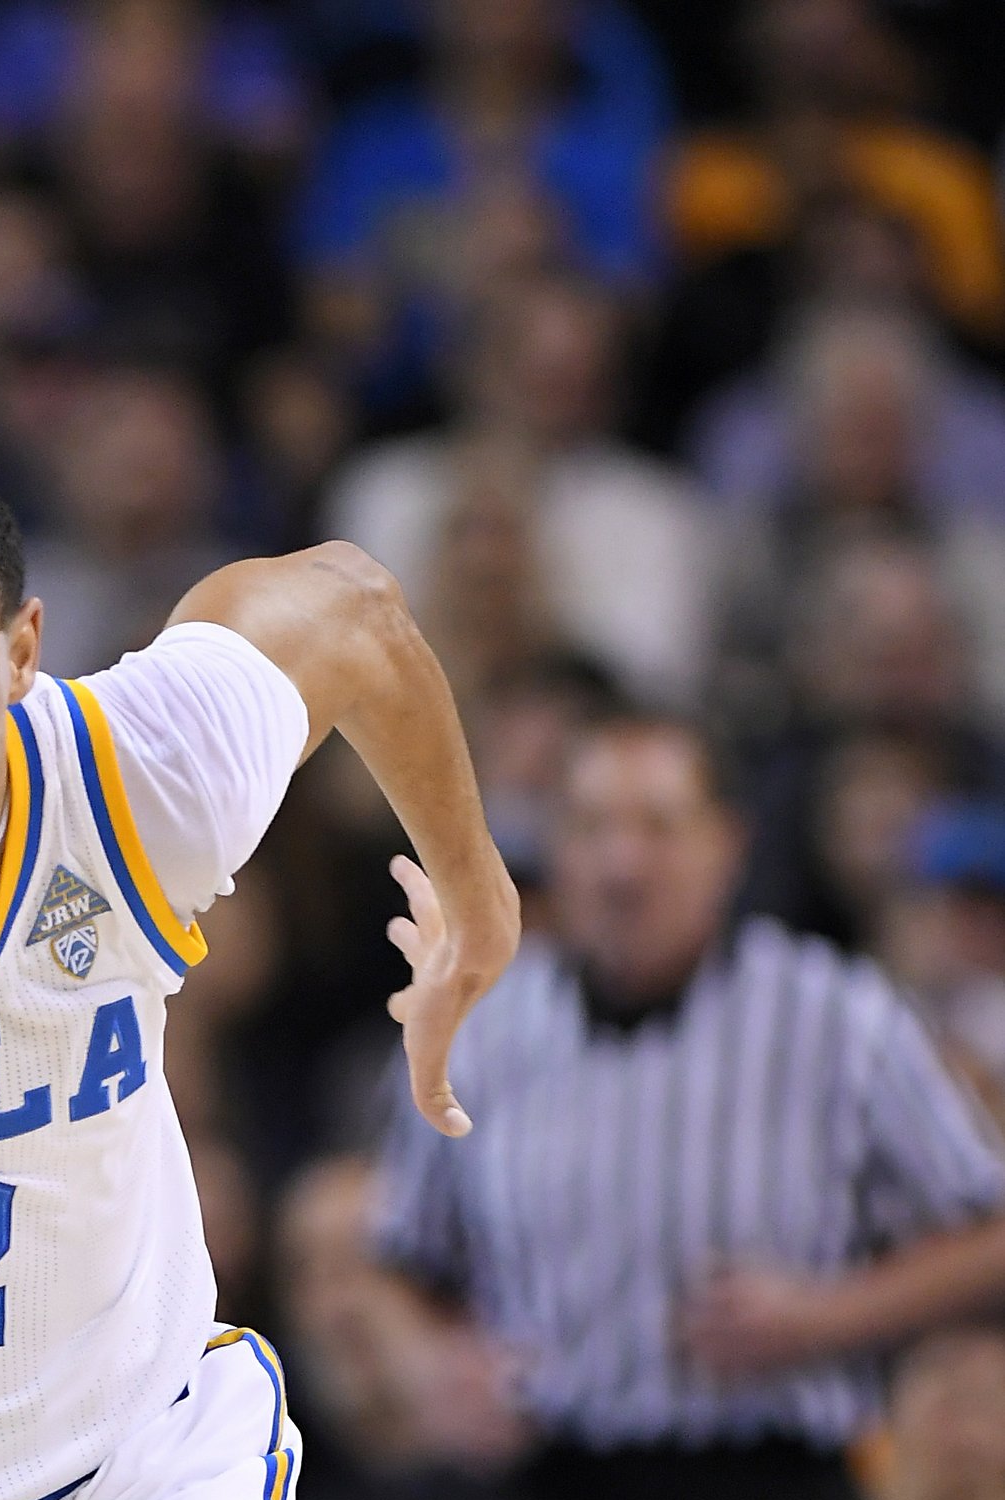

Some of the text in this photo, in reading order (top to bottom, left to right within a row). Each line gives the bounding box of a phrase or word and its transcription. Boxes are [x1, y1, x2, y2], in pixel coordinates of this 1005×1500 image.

[40, 893, 91, 931] JRW
[55, 925, 97, 967] PAC
[70, 948, 92, 974] 12
